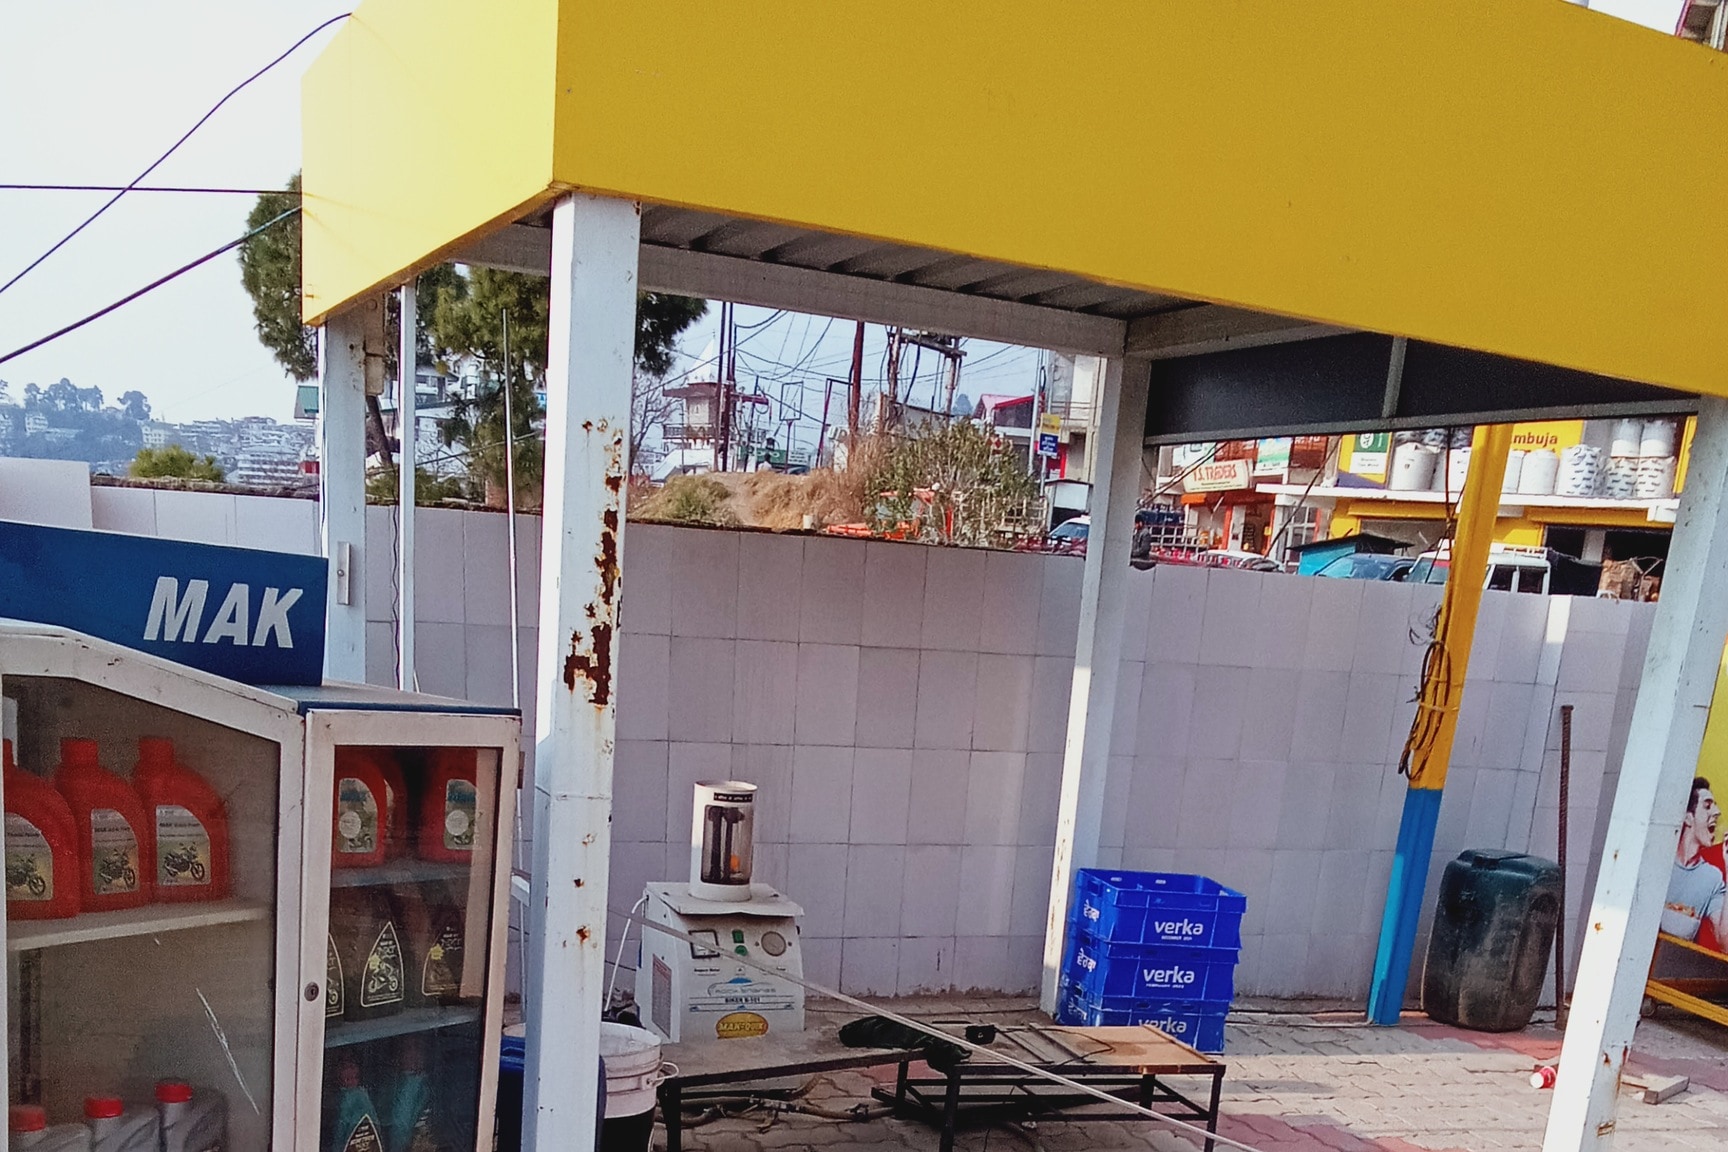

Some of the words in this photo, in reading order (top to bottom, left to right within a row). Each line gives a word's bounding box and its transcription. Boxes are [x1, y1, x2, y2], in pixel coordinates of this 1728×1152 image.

[143, 576, 303, 649] MAK
[1154, 918, 1204, 935] verka
[1143, 965, 1195, 984] verka
